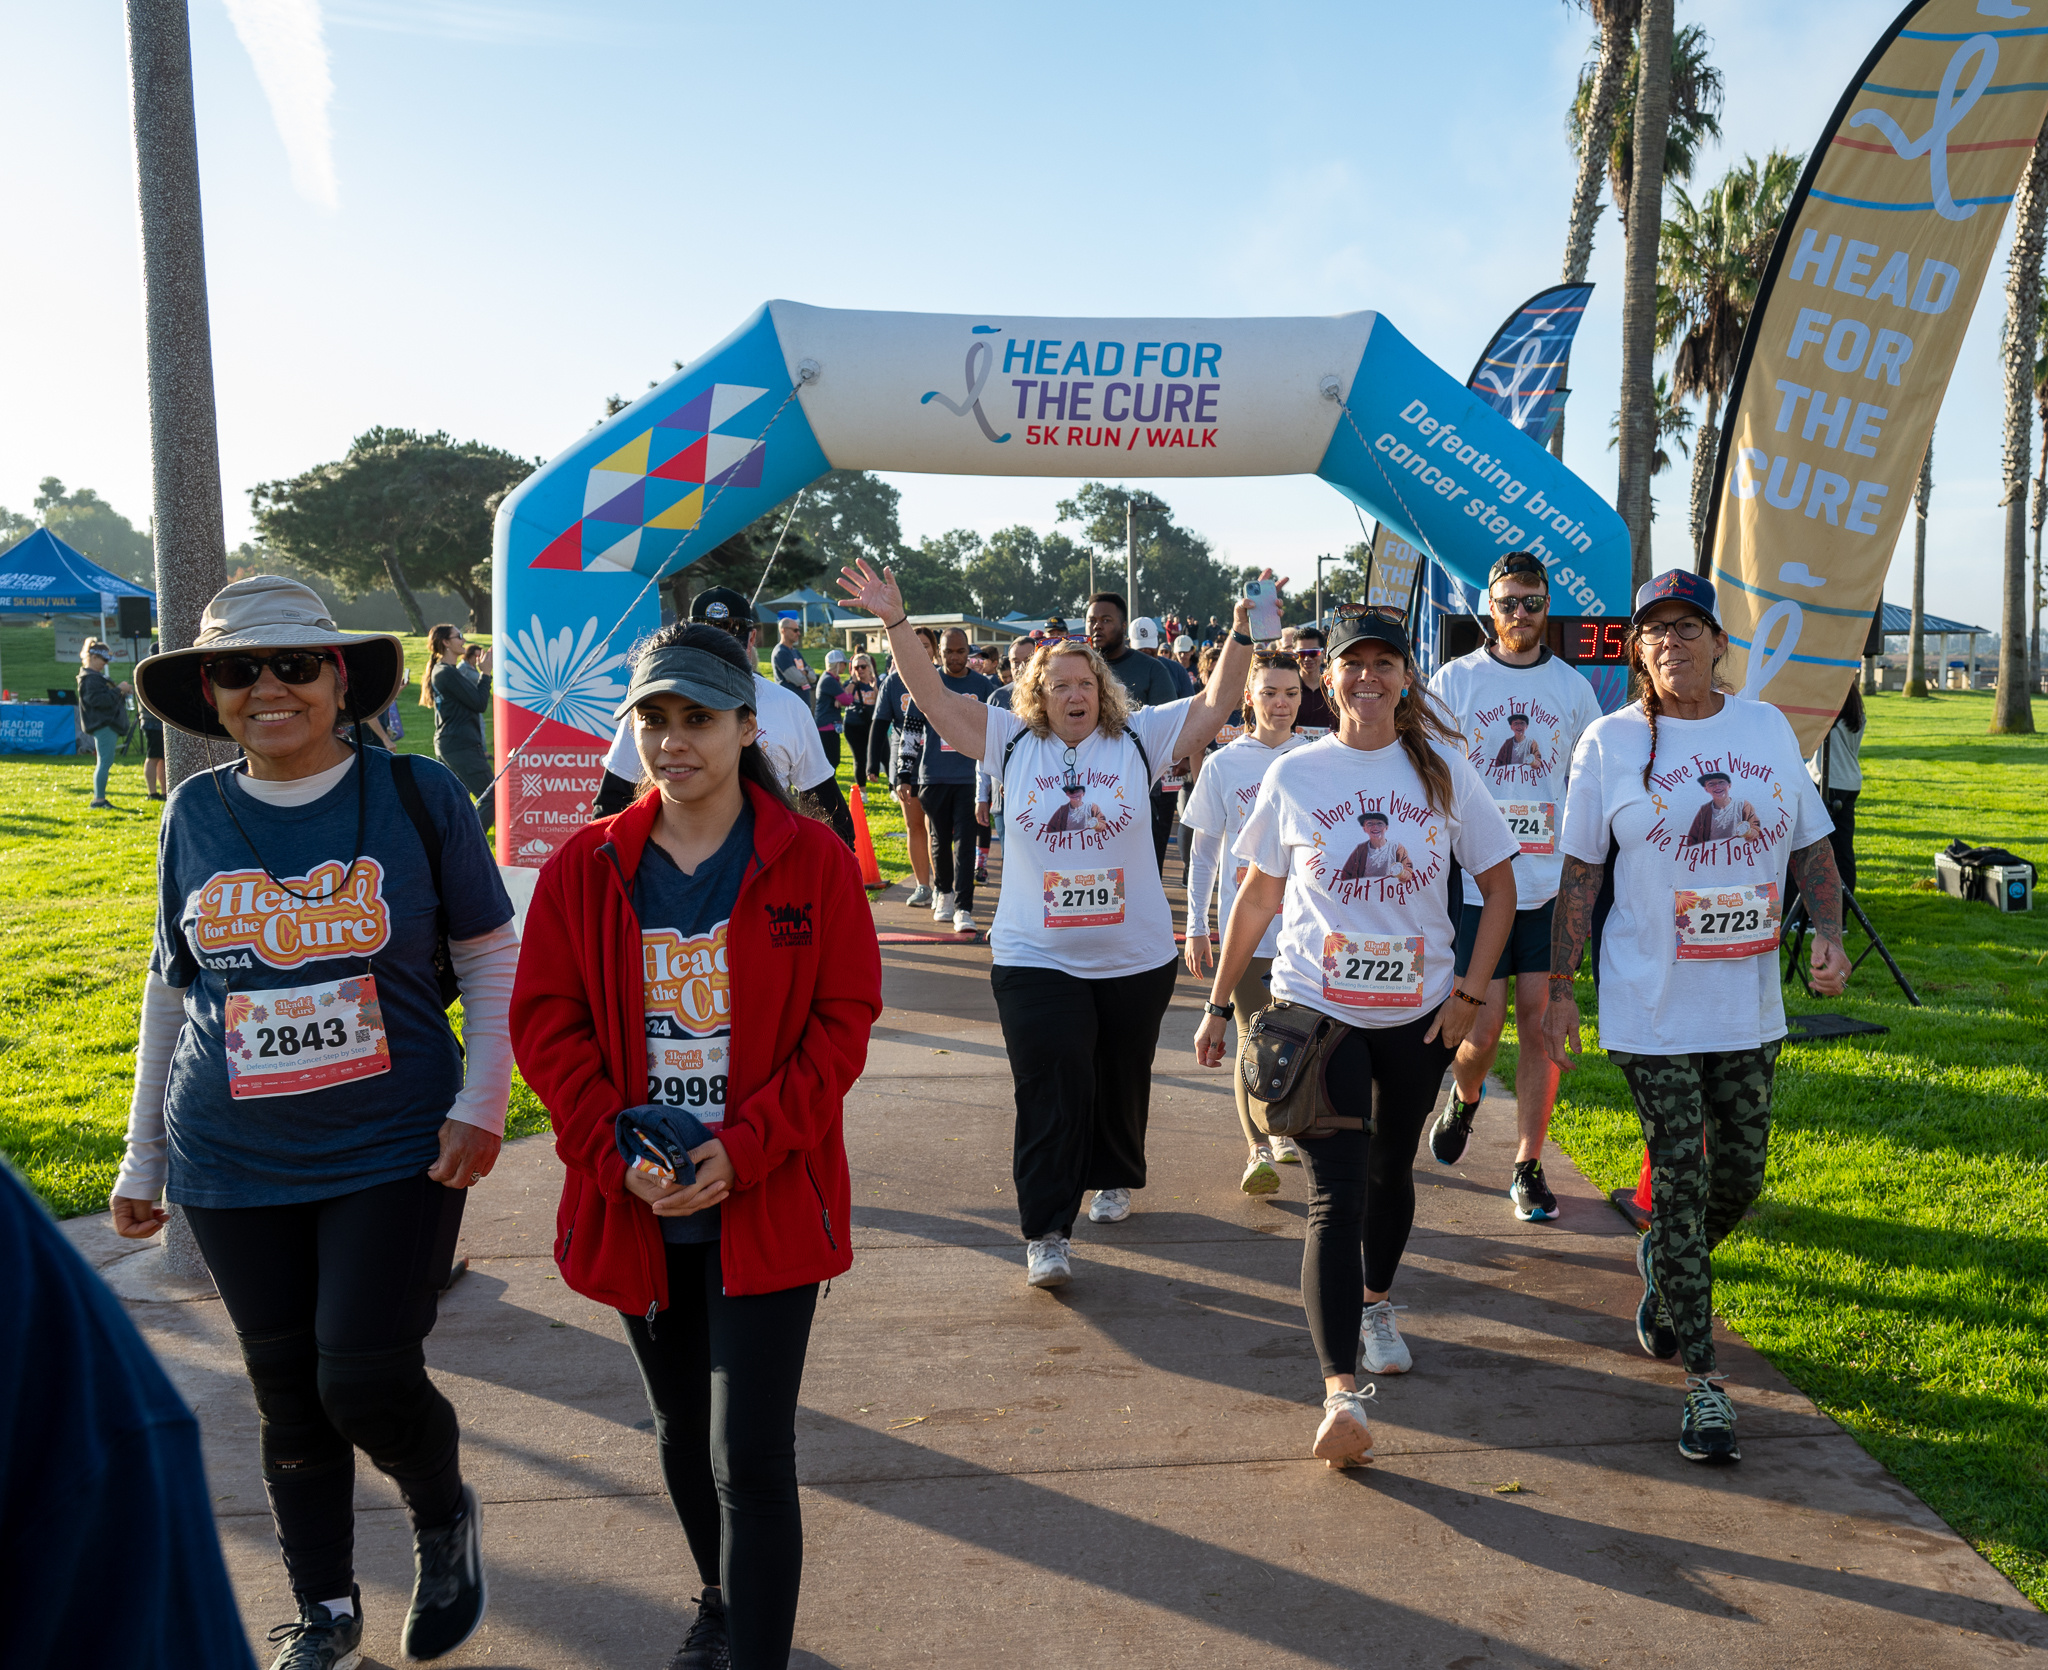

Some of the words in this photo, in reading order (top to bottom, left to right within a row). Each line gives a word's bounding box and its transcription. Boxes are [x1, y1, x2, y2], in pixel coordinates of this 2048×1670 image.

[1789, 228, 1960, 314] HEAD
[1002, 338, 1125, 376] HEAD
[1133, 342, 1222, 378] FOR
[1786, 307, 1914, 386] FOR
[1011, 380, 1094, 421] THE
[1102, 382, 1221, 423] CURE
[1775, 379, 1888, 458] THE
[1025, 425, 1061, 446] 5K
[1067, 426, 1122, 447] RUN
[1127, 427, 1140, 450] /
[1146, 427, 1219, 448] WALK
[1399, 399, 1527, 504] Defeating
[1524, 491, 1593, 553] brain
[1730, 447, 1889, 535] CURE
[1374, 433, 1469, 502] cancer
[1463, 498, 1526, 545] step
[1554, 566, 1607, 617] step
[13, 597, 25, 606] 5K
[26, 597, 45, 606] RUN
[51, 597, 77, 606] WALK
[1579, 624, 1622, 658] 35
[25, 720, 44, 729] FOR
[1474, 704, 1506, 728] Hope
[1507, 695, 1529, 716] For
[1530, 697, 1560, 729] Wyatt
[0, 728, 16, 738] THE
[18, 728, 43, 738] CURE
[1034, 775, 1061, 791] Hope
[1086, 766, 1120, 789] Wyatt
[1468, 745, 1487, 769] We
[1485, 758, 1517, 786] Fight
[1650, 765, 1693, 792] Hope
[1690, 753, 1722, 776] For
[1727, 751, 1774, 783] Wyatt
[543, 778, 603, 792] VMLY&
[523, 811, 543, 824] GT
[1312, 800, 1355, 830] Hope
[1355, 789, 1385, 815] For
[1389, 790, 1434, 827] Wyatt
[1015, 807, 1036, 833] We
[1035, 822, 1074, 853] Fight
[1074, 803, 1136, 850] Together!
[1506, 818, 1540, 835] 724
[1645, 817, 1673, 852] We
[1674, 834, 1719, 872] Fight
[1719, 807, 1793, 866] Together!
[1305, 850, 1327, 880] We
[1327, 868, 1372, 905] Fight
[1374, 850, 1446, 906] Together!
[206, 872, 336, 919] Head
[1062, 888, 1109, 907] 2719
[204, 922, 229, 939] for
[230, 917, 261, 935] the
[263, 911, 378, 956] Cure
[769, 920, 811, 936] UTLA
[1700, 909, 1759, 934] 2723
[206, 952, 253, 970] 2024
[1345, 957, 1404, 982] 2722
[651, 984, 679, 1002] the
[256, 1017, 348, 1058] 2843
[246, 1062, 278, 1070] Defeating
[278, 1060, 296, 1068] Brain
[297, 1056, 322, 1065] Cancer
[323, 1052, 340, 1060] Step
[350, 1046, 367, 1055] Step
[667, 1051, 693, 1060] Head
[678, 1059, 701, 1069] Cure
[648, 1074, 729, 1107] 2998
[704, 1110, 720, 1118] Step
